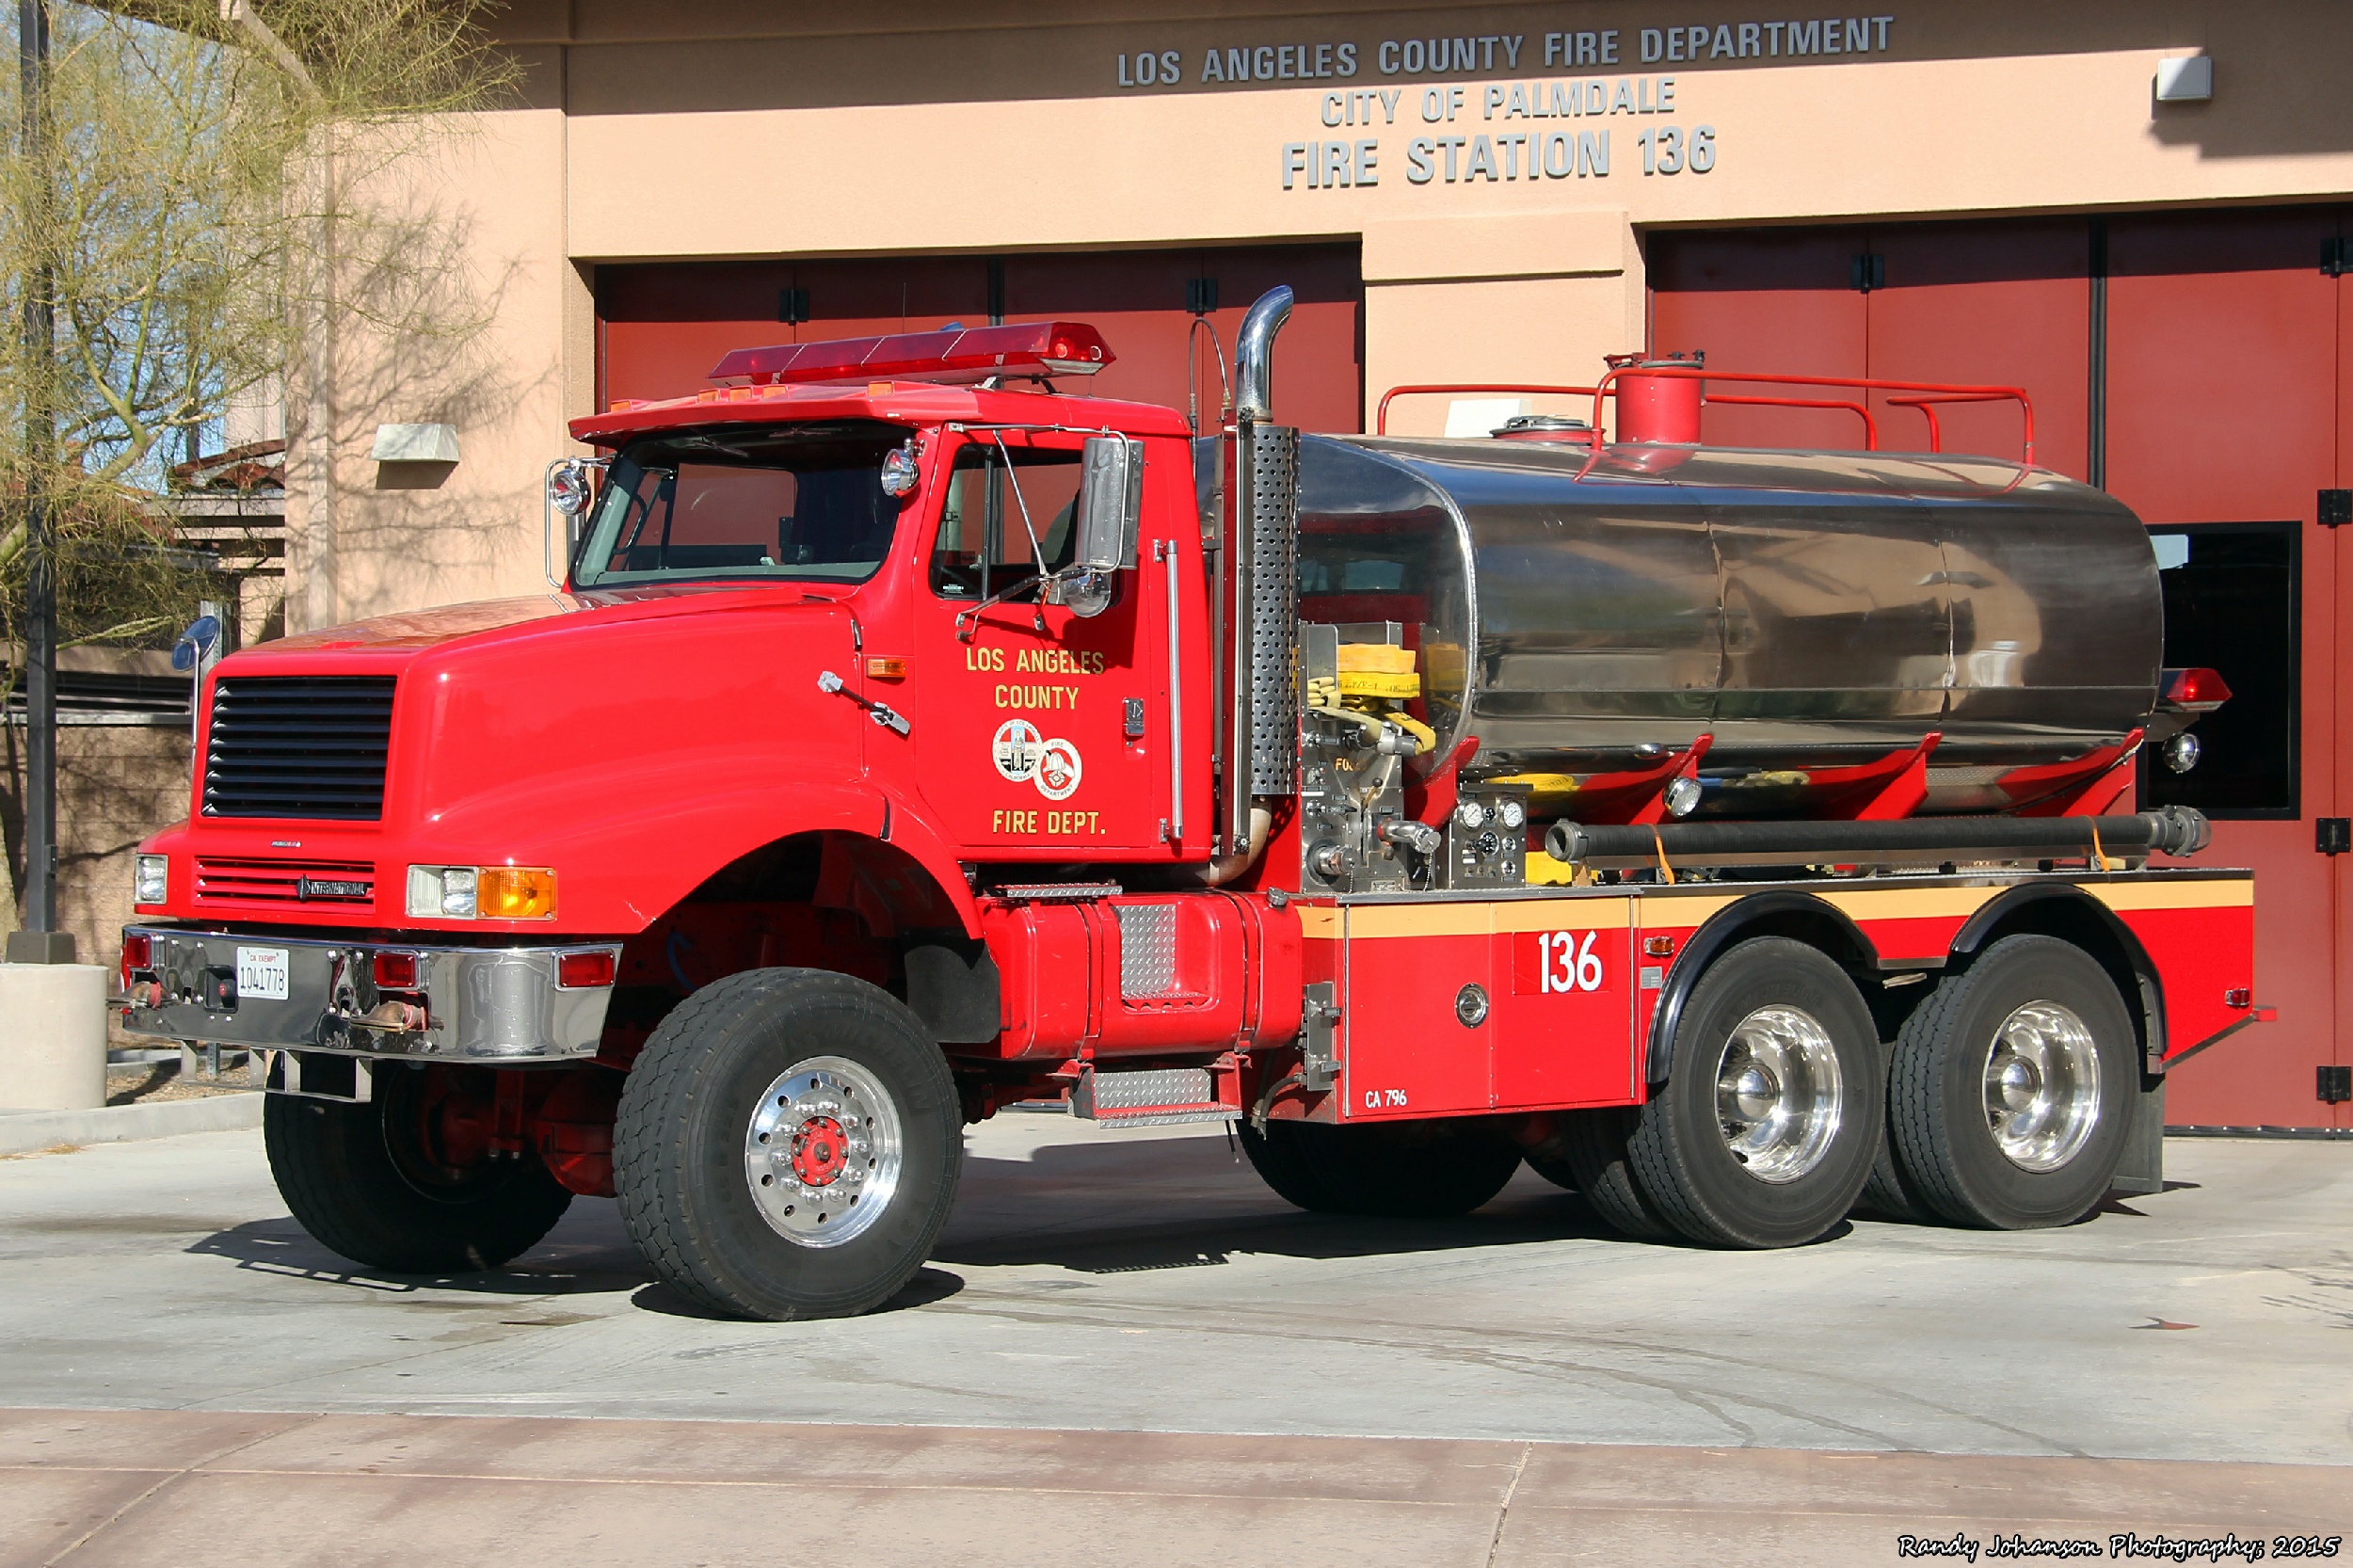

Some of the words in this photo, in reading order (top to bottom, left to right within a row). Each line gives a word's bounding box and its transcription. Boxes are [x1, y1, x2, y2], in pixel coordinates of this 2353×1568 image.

[1118, 51, 1180, 87] LOS
[1201, 43, 1357, 83] ANGELES
[1378, 36, 1523, 75] COUNTY
[1545, 30, 1619, 68] FIRE
[1641, 16, 1894, 63] DEPARTMENT
[1321, 88, 1401, 126] CITY
[1421, 87, 1465, 122] OF
[1484, 76, 1675, 120] PALMDALE
[1282, 139, 1378, 190] FIRE
[1406, 129, 1609, 185] STATION
[1638, 125, 1716, 177] 136
[966, 647, 1005, 672] LOS
[1016, 649, 1105, 675] ANGELES
[995, 684, 1080, 710] COUNTY
[1040, 784, 1074, 796] DEPARTMENT
[992, 809, 1038, 834] FIRE
[1048, 811, 1106, 835] DEPT.
[1538, 930, 1603, 994] 136
[240, 967, 285, 991] 1041778
[1366, 1090, 1382, 1108] CA
[1385, 1089, 1407, 1107] 796
